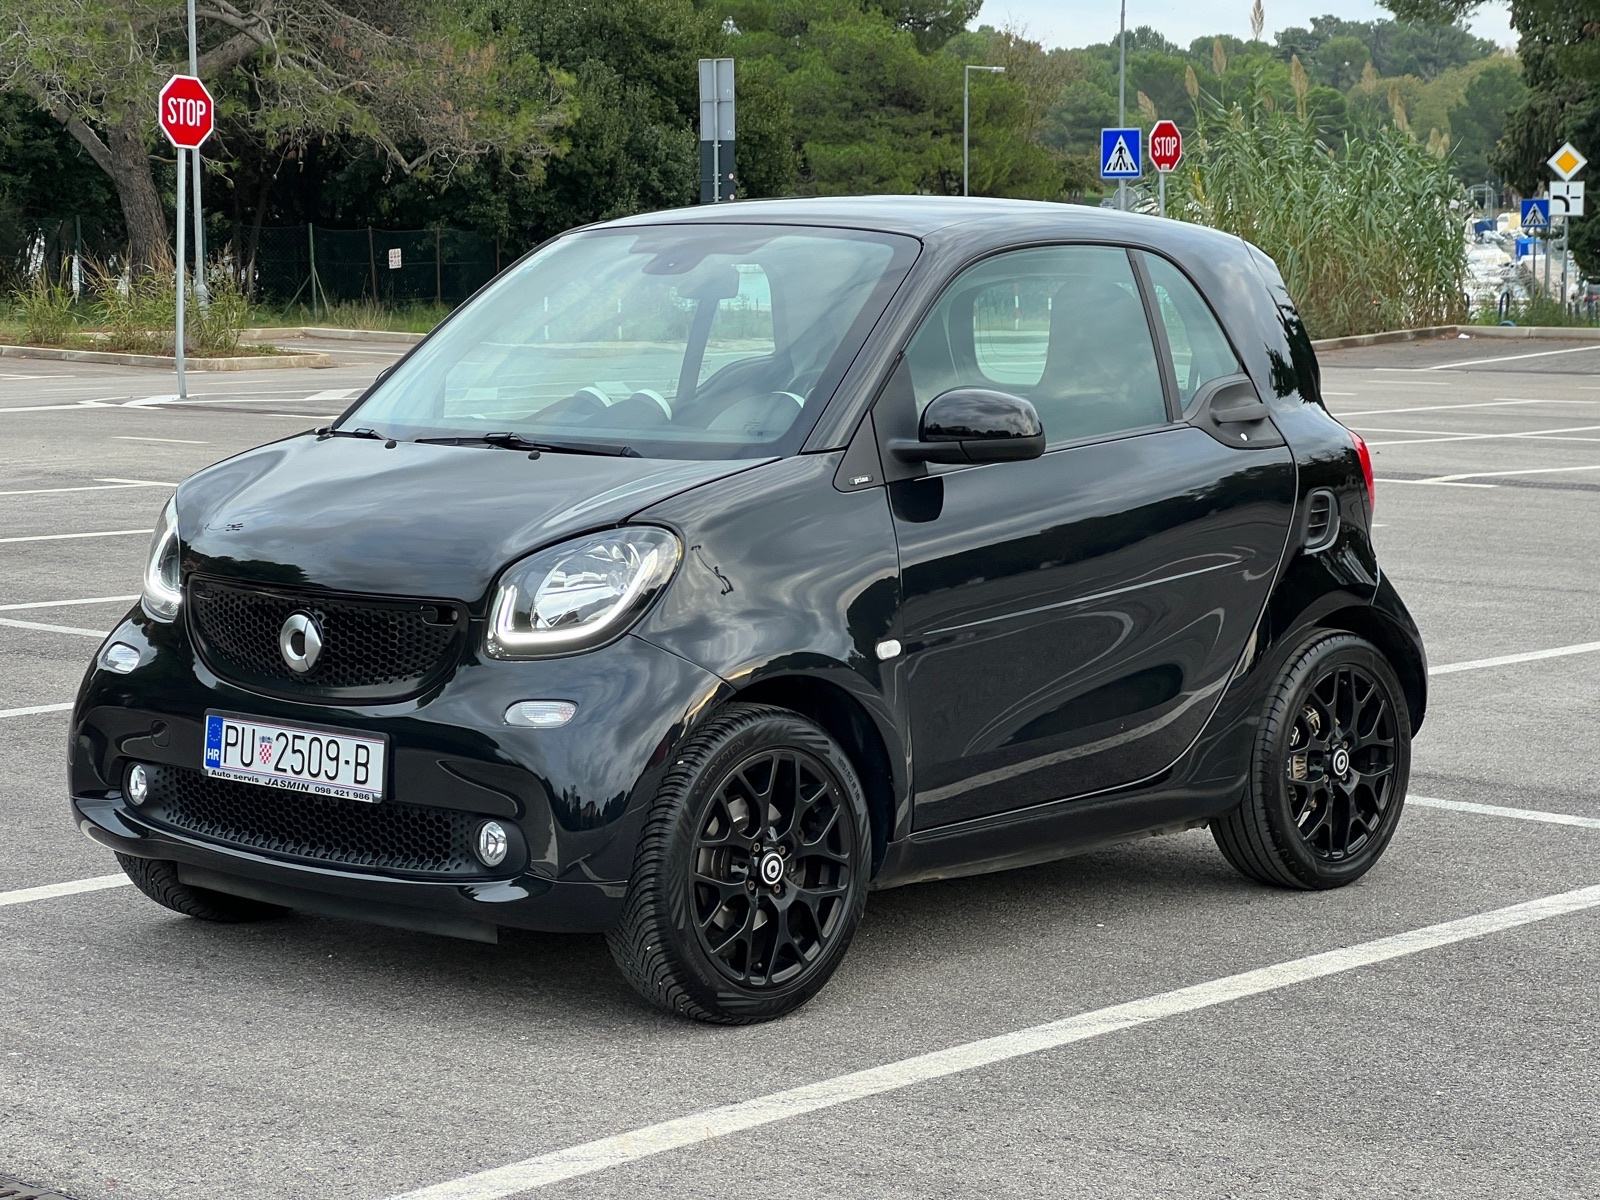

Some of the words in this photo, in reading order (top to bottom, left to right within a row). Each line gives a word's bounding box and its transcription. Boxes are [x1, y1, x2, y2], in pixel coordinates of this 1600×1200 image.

[167, 96, 207, 127] STOP
[1154, 136, 1178, 157] STOP
[207, 748, 220, 761] HR
[223, 724, 256, 767] PU
[273, 731, 370, 785] 2509-B
[211, 769, 231, 778] Auto
[233, 773, 260, 784] servis
[264, 777, 310, 792] JASMIN
[314, 786, 331, 795] 098
[333, 789, 350, 798] 421
[353, 792, 370, 801] 986
